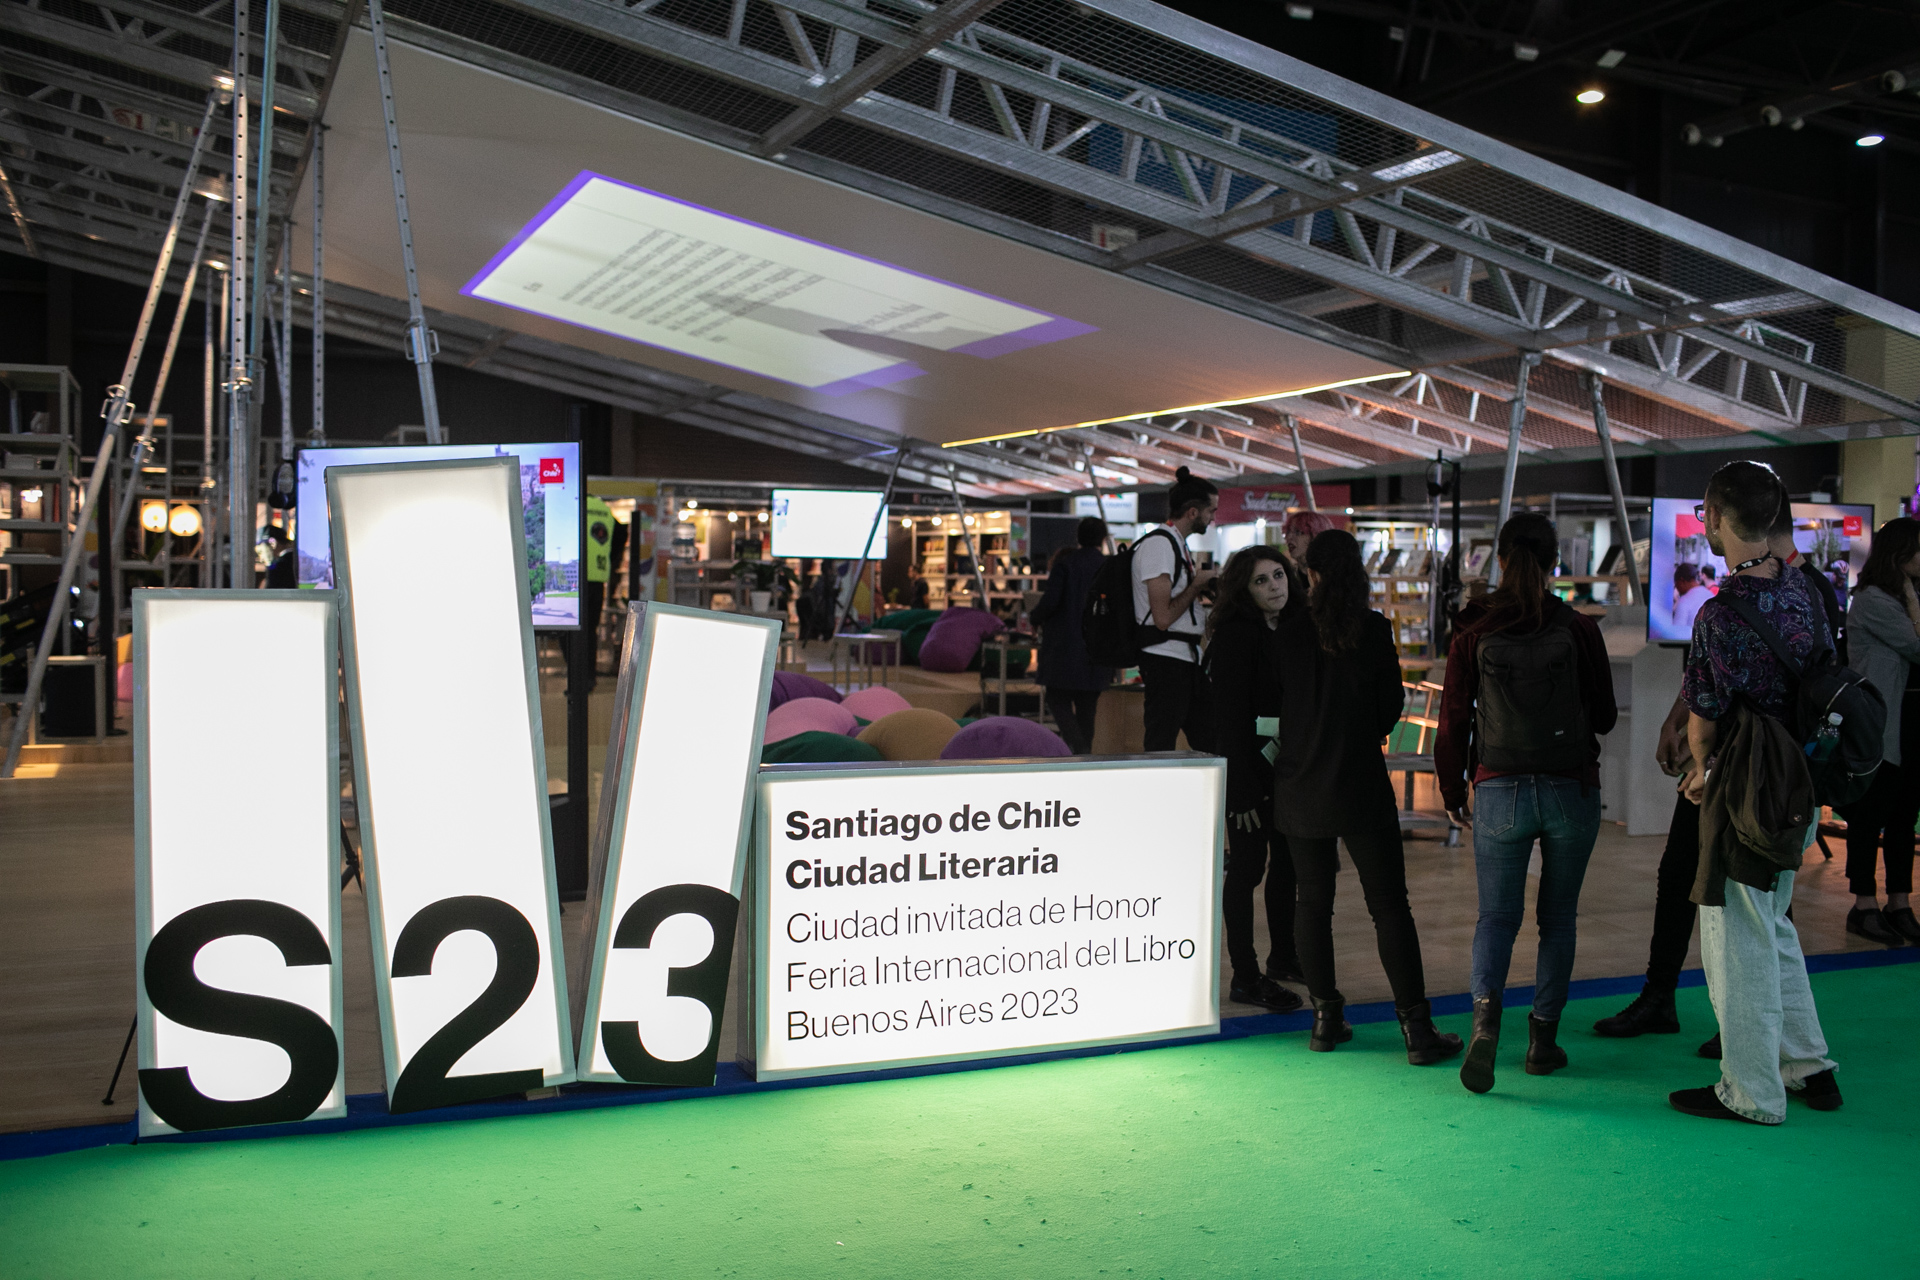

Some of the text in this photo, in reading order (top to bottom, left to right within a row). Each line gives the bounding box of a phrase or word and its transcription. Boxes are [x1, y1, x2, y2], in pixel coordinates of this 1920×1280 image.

[786, 800, 1081, 841] Santiago de Chile
[786, 847, 1058, 889] Ciudad Literaria
[787, 894, 1161, 943] Ciudad invitada de Honor
[788, 935, 1195, 992] Feria Internacional del Libro
[788, 988, 1078, 1041] Buenos Aires 2023
